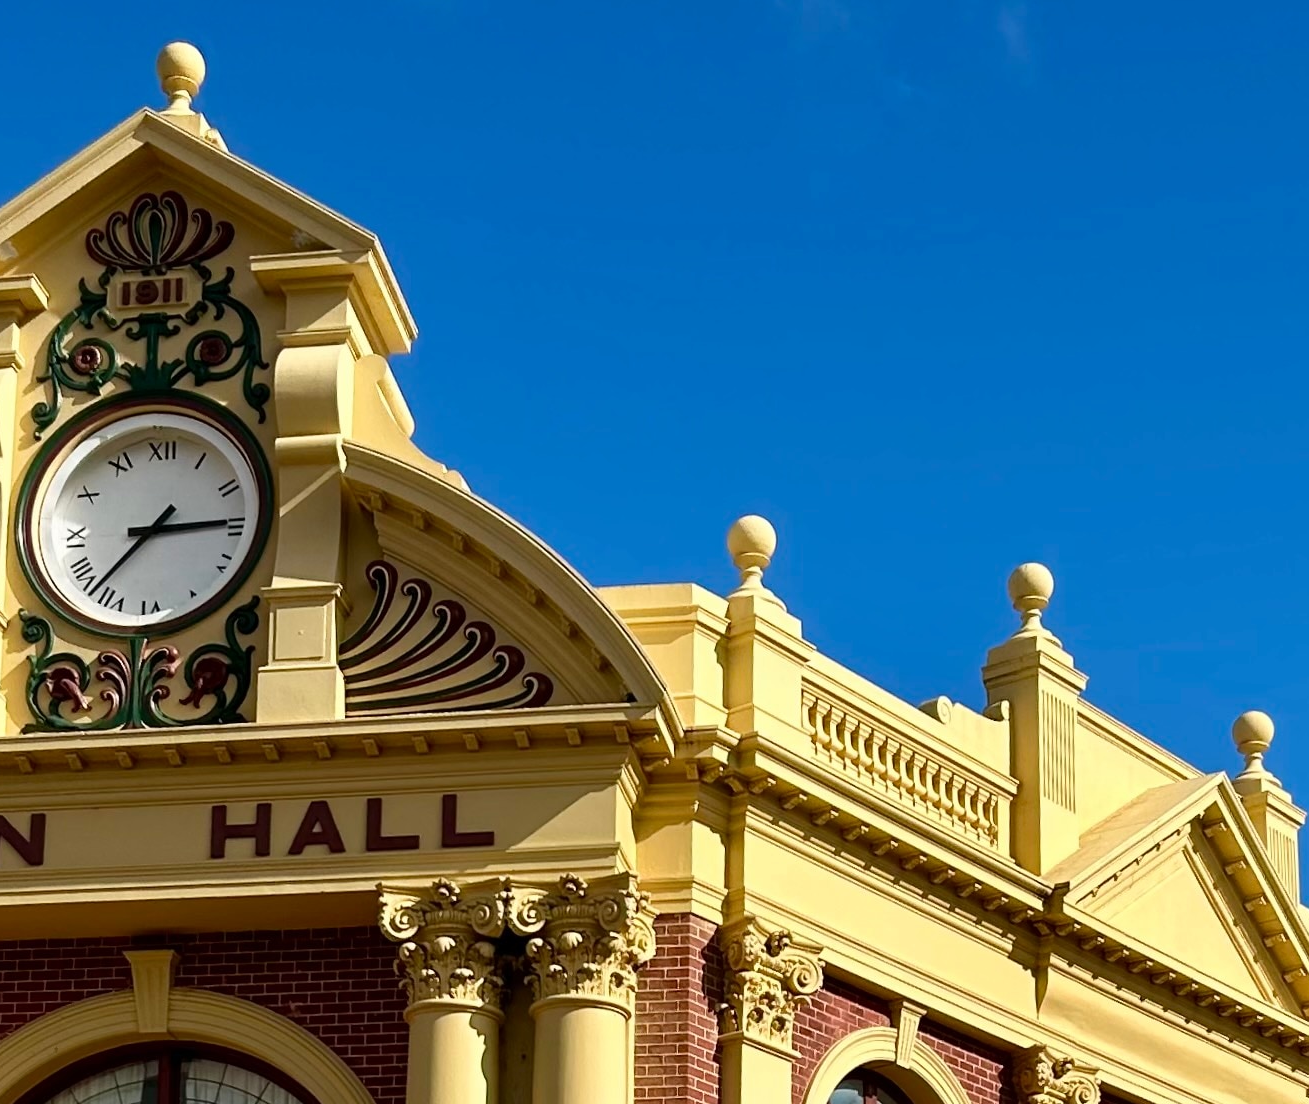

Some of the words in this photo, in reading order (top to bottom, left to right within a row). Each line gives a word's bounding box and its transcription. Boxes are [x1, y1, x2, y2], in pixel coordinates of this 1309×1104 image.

[121, 278, 183, 306] 1911
[148, 440, 177, 462] XII
[107, 452, 134, 477] XI
[77, 485, 100, 505] X
[209, 793, 496, 860] HALL
